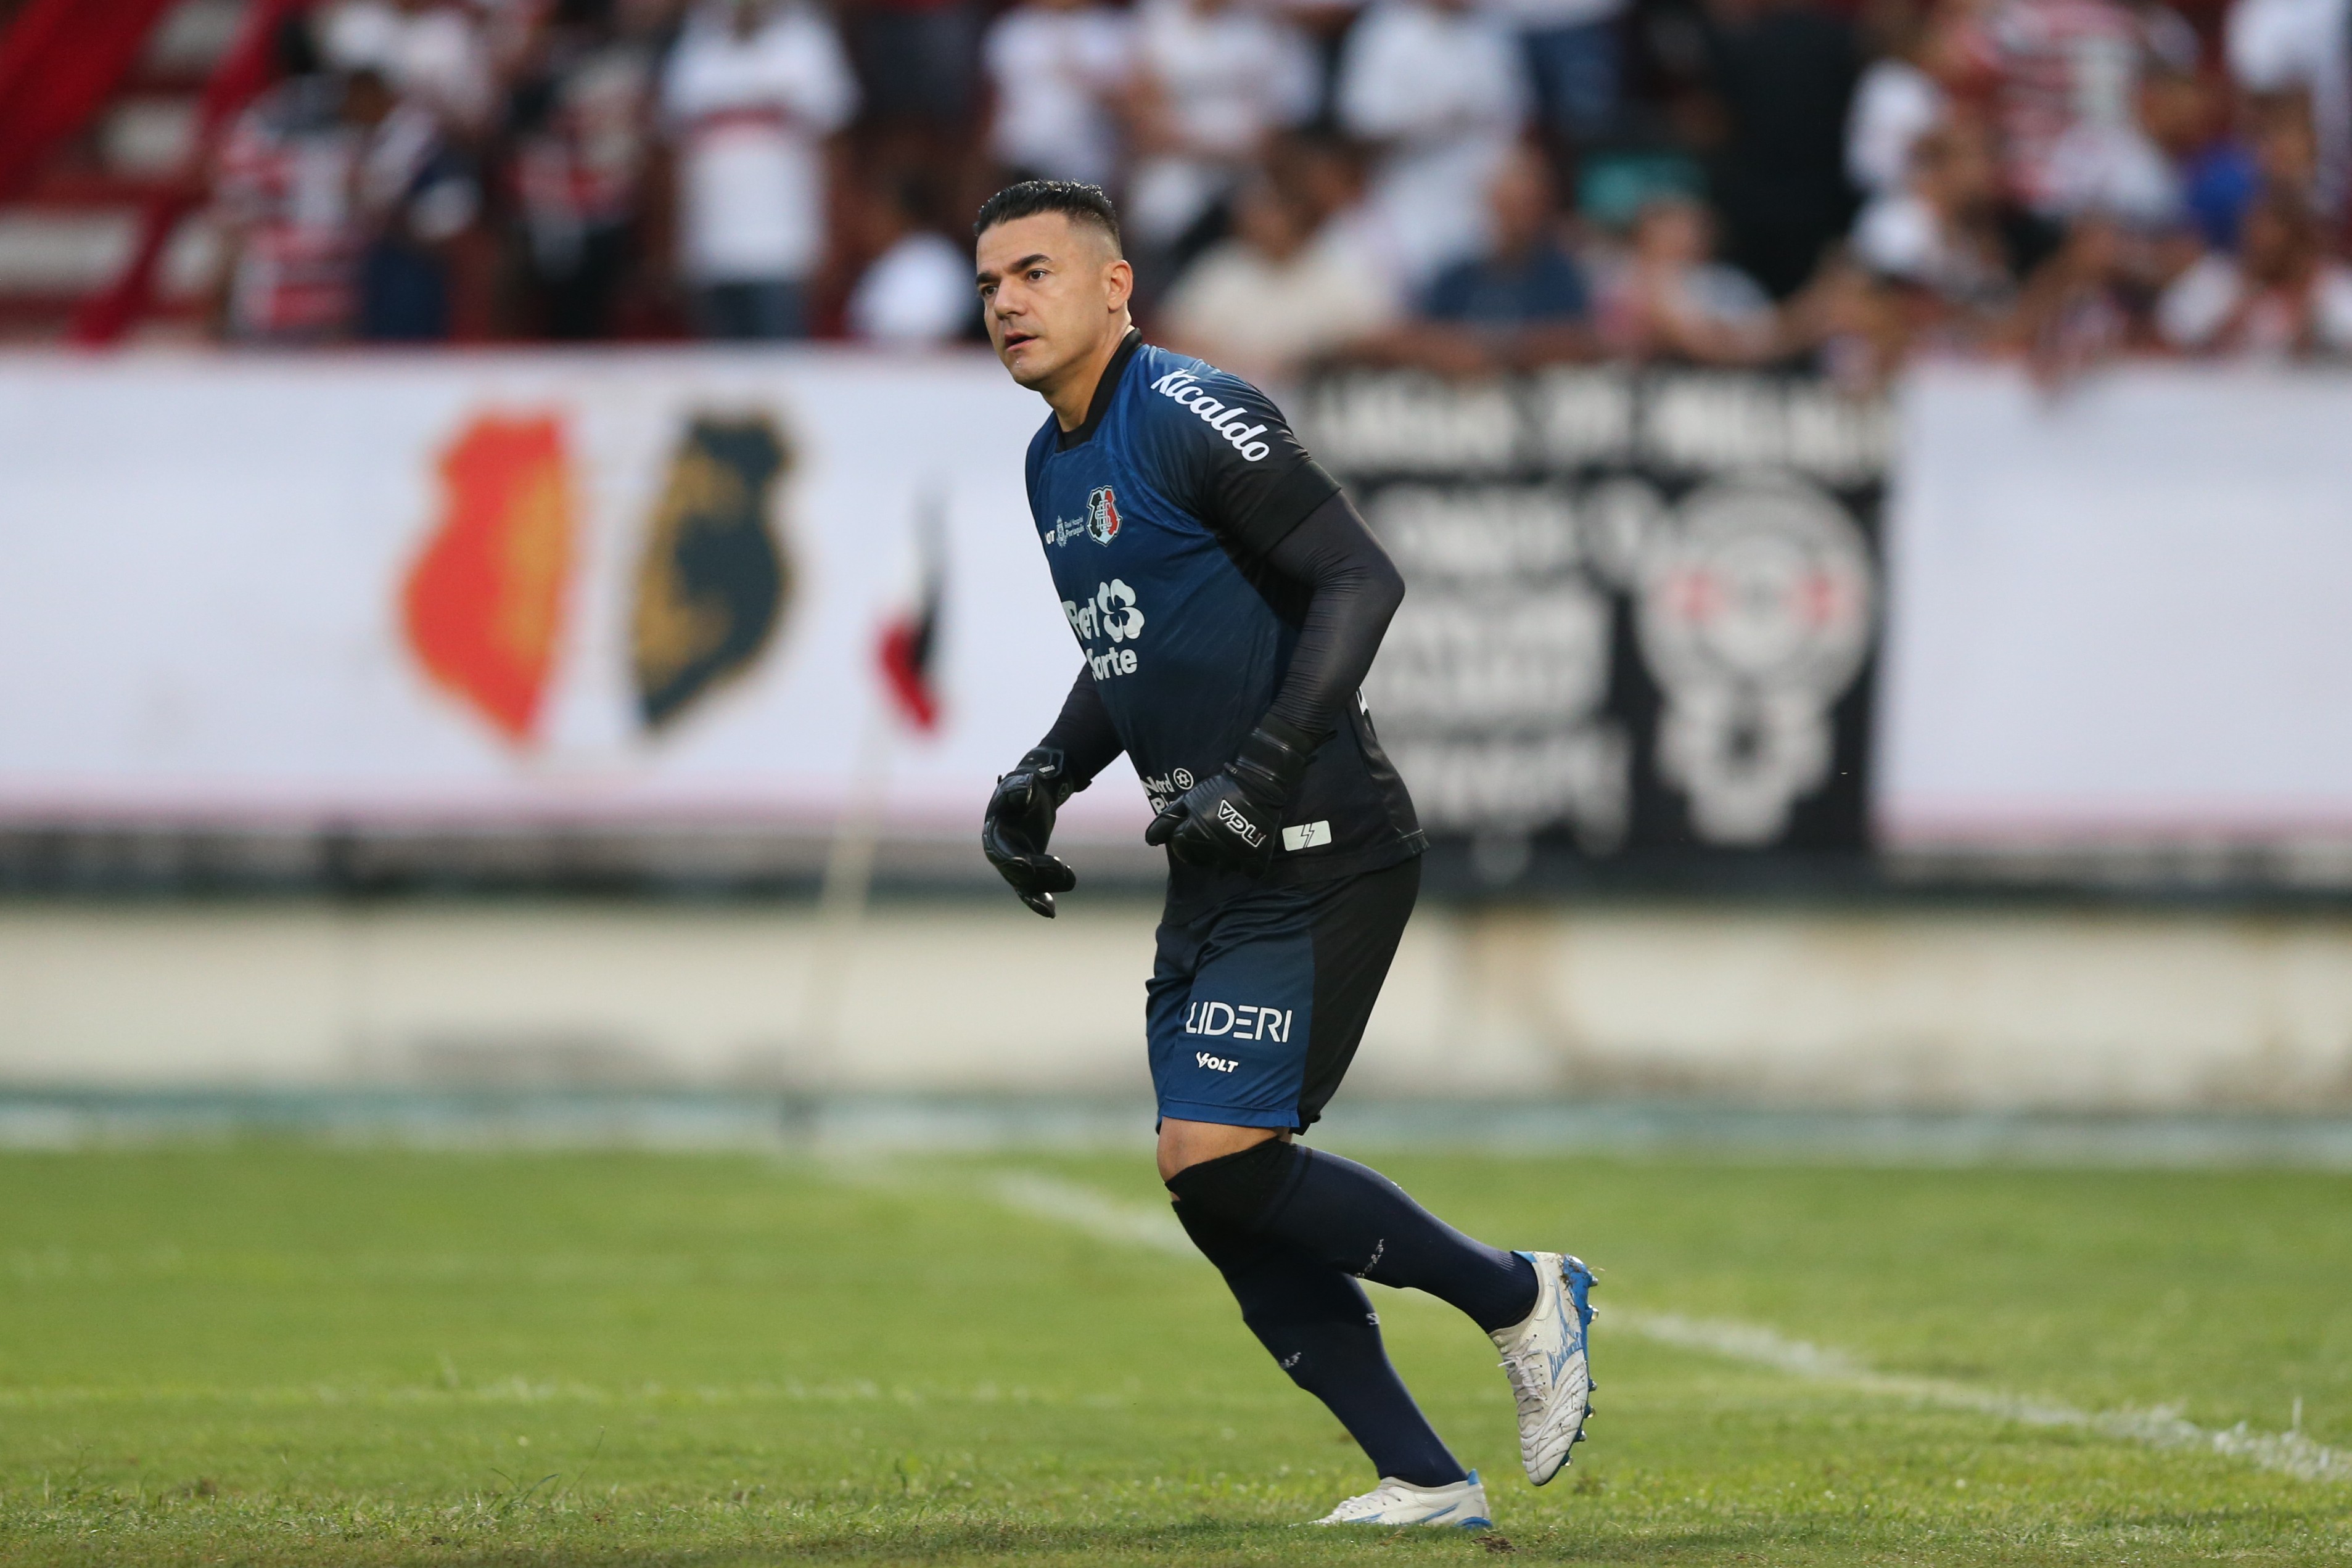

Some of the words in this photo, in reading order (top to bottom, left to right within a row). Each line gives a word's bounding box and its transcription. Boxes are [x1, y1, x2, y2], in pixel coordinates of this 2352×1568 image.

[1150, 367, 1270, 462] Kicaldo
[1185, 1001, 1293, 1043] LIDERI
[1196, 1051, 1239, 1073] VOLT
